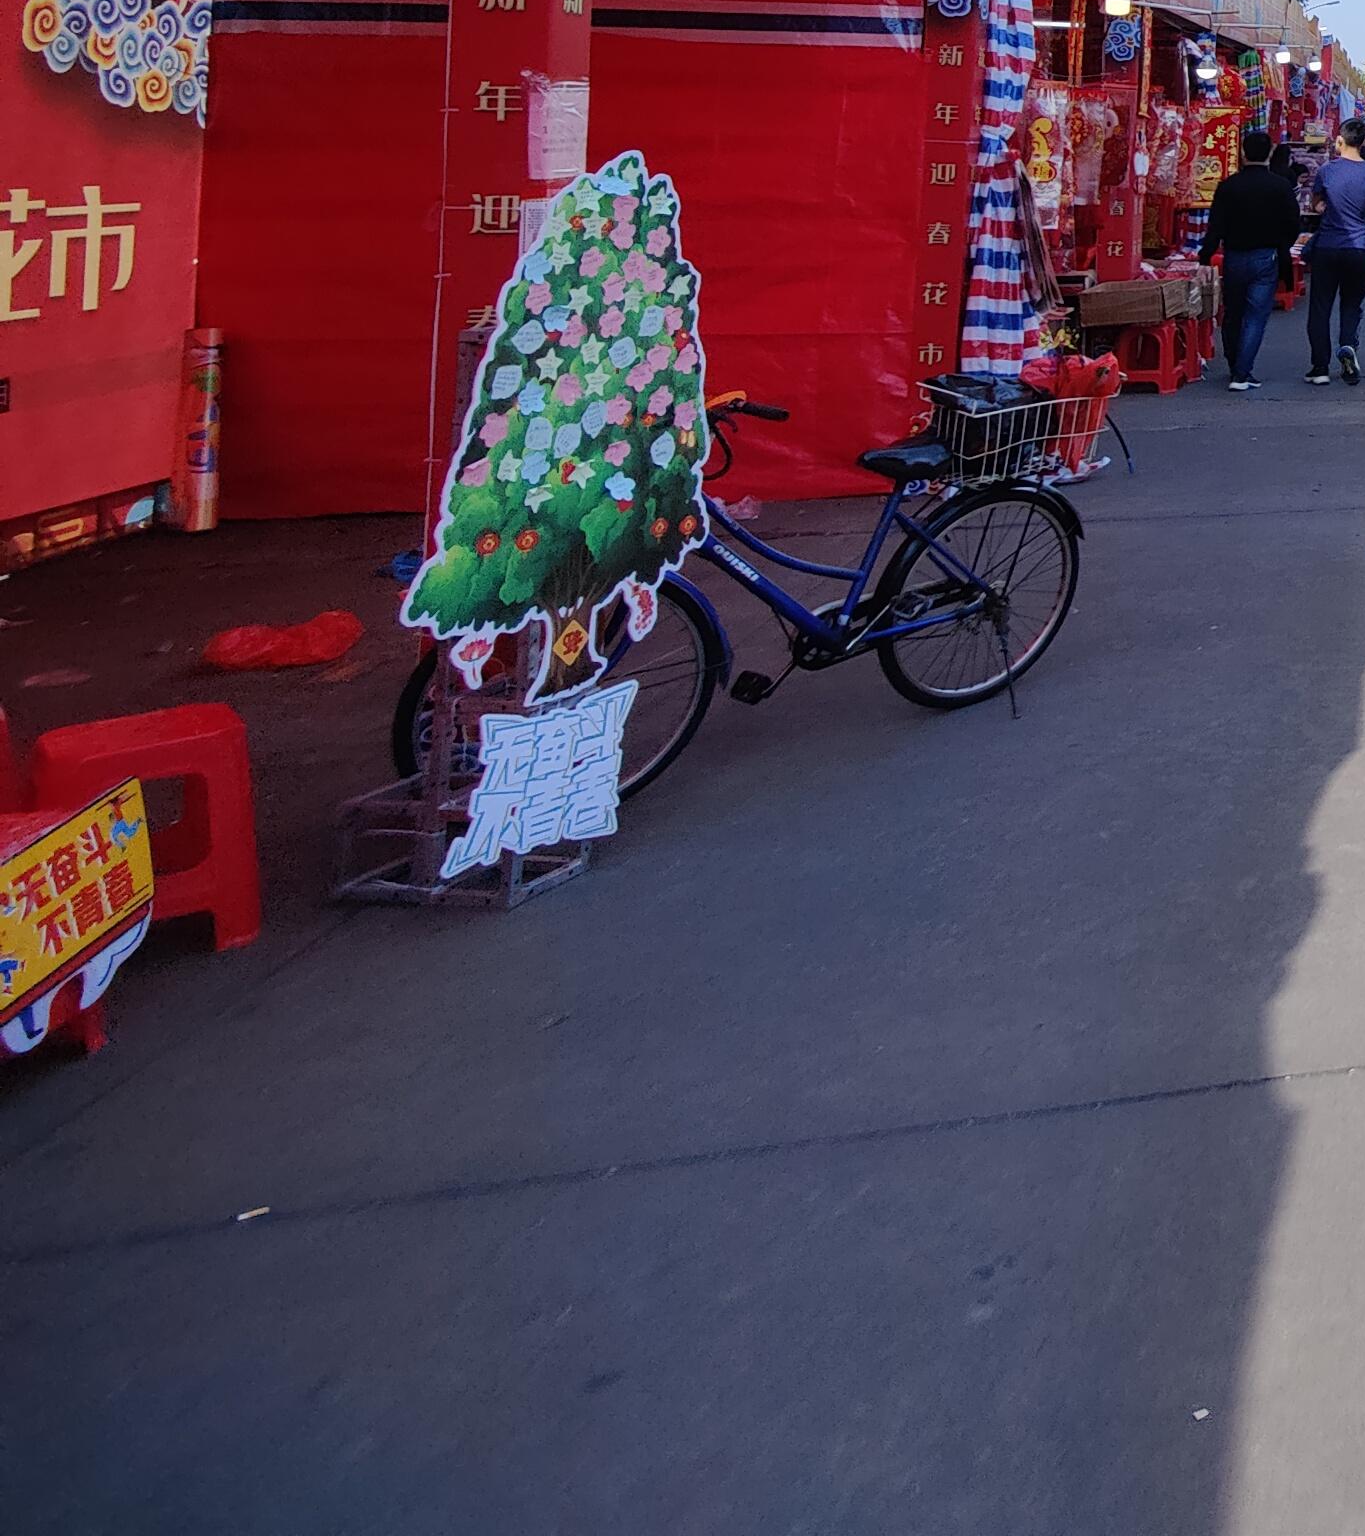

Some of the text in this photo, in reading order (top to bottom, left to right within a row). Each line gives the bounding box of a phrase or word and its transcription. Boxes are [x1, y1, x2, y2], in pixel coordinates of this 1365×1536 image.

[918, 44, 964, 366] 新年迎春花市
[9, 822, 113, 925] 无奋斗
